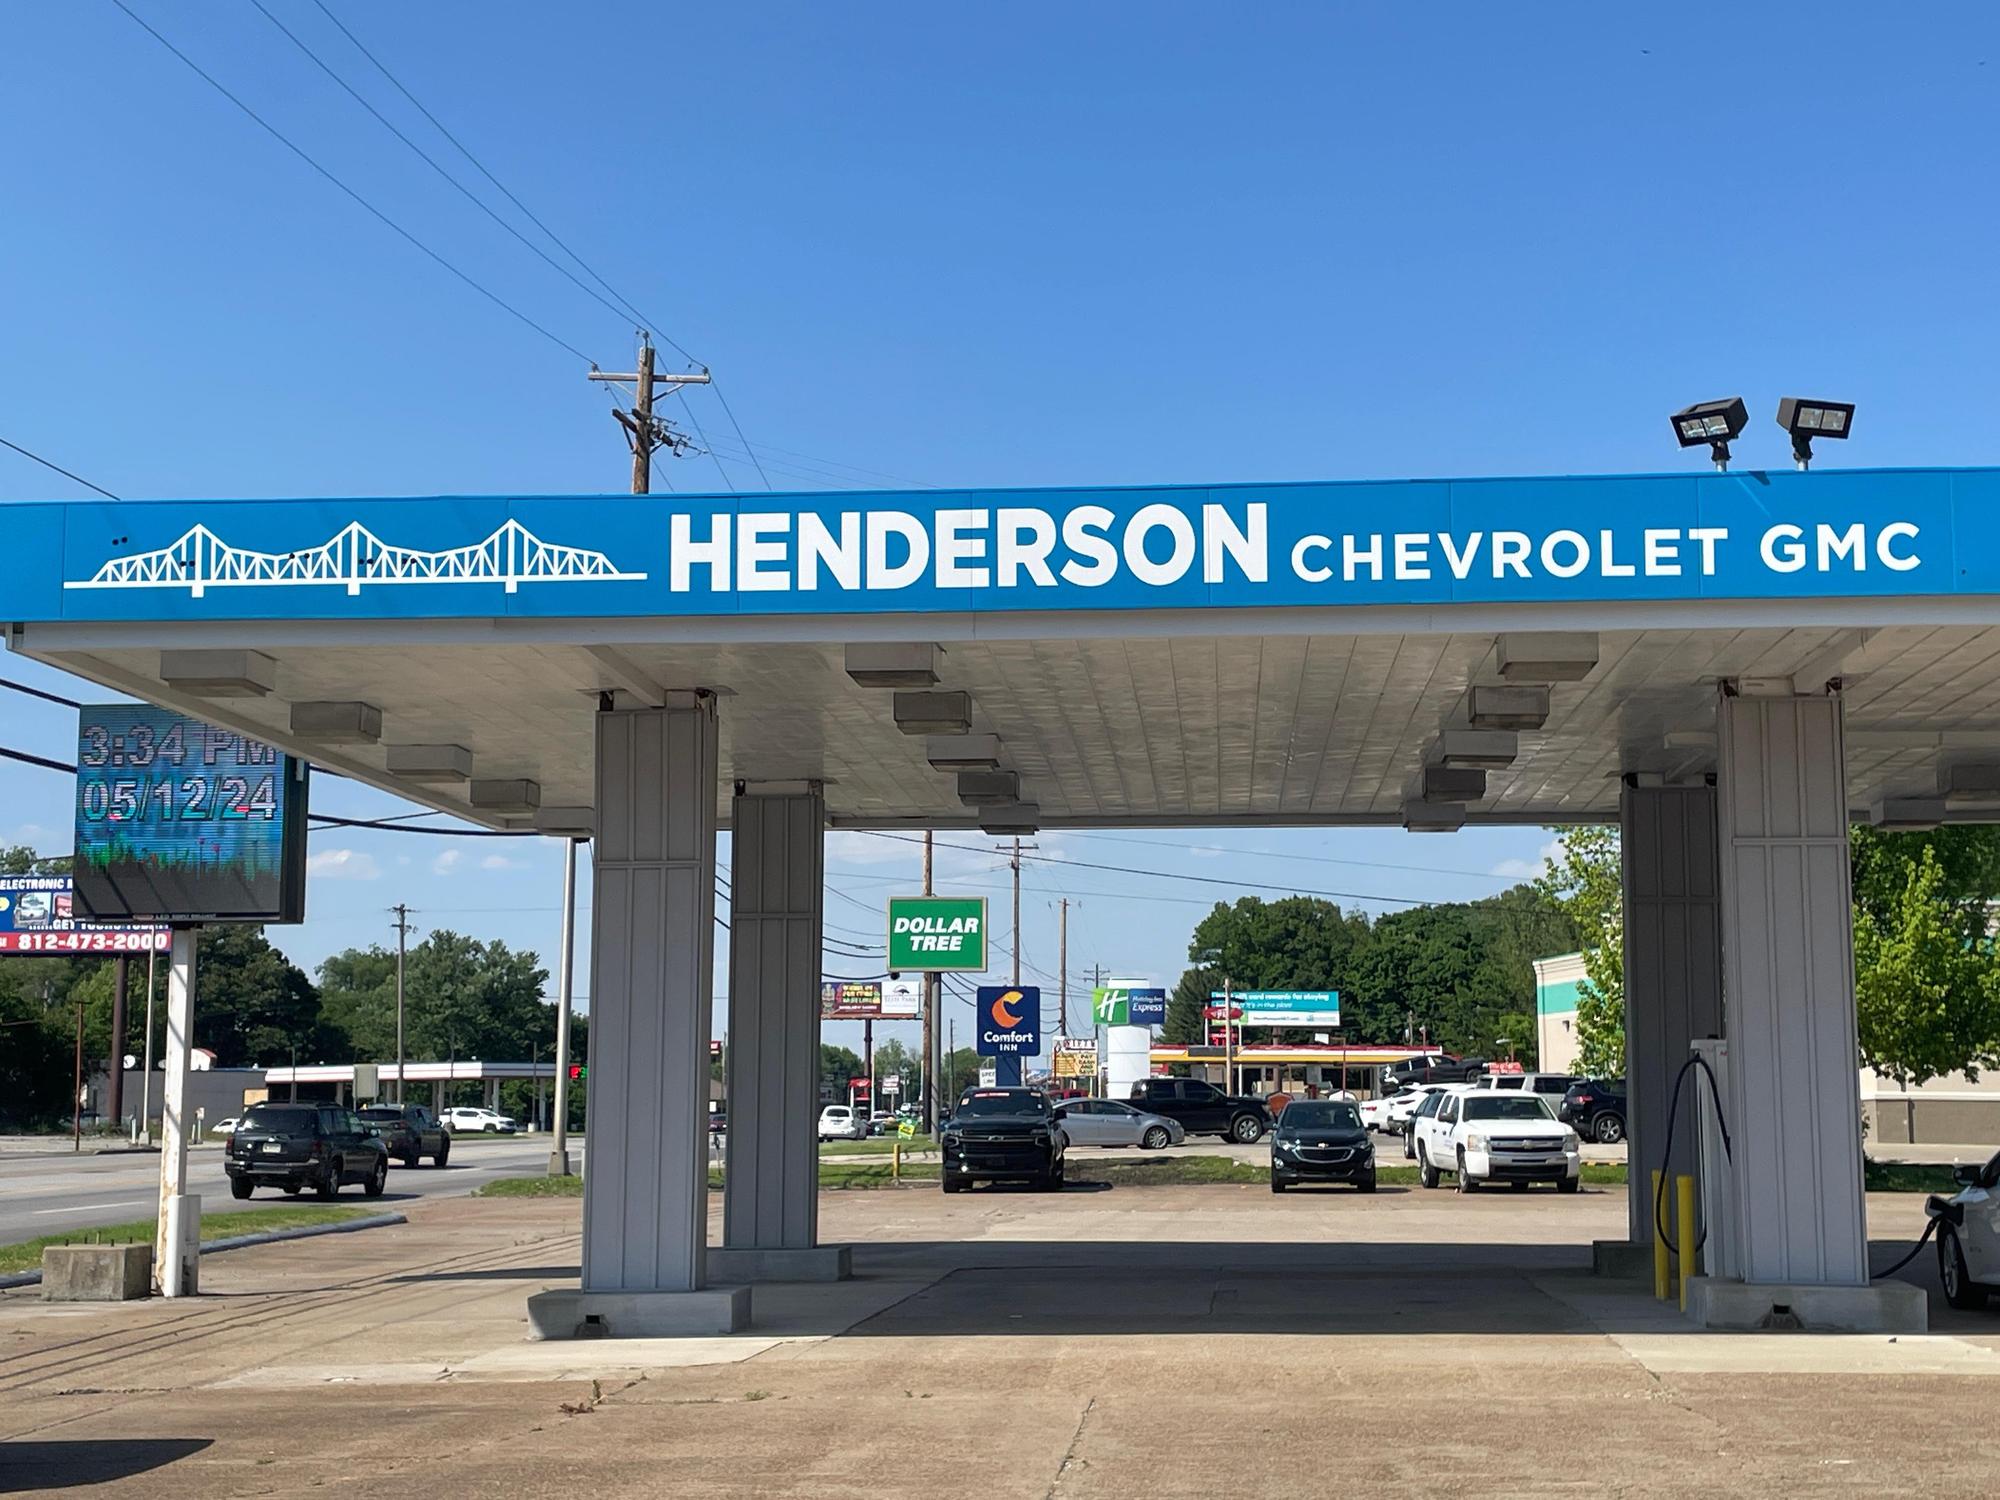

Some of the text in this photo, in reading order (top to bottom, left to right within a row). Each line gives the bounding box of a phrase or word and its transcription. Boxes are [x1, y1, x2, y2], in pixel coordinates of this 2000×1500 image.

[669, 502, 1922, 592] HENDERSON CHEVROLET GMC
[81, 723, 187, 766] 3:34
[82, 774, 278, 822] 05/12/24
[0, 878, 64, 890] ELECTRONIC
[894, 917, 979, 933] DOLLAR
[18, 933, 168, 950] 812-473-2000
[910, 936, 963, 951] TREE
[1132, 1003, 1163, 1013] Express
[983, 1031, 1033, 1043] Comfort
[999, 1043, 1018, 1051] INN
